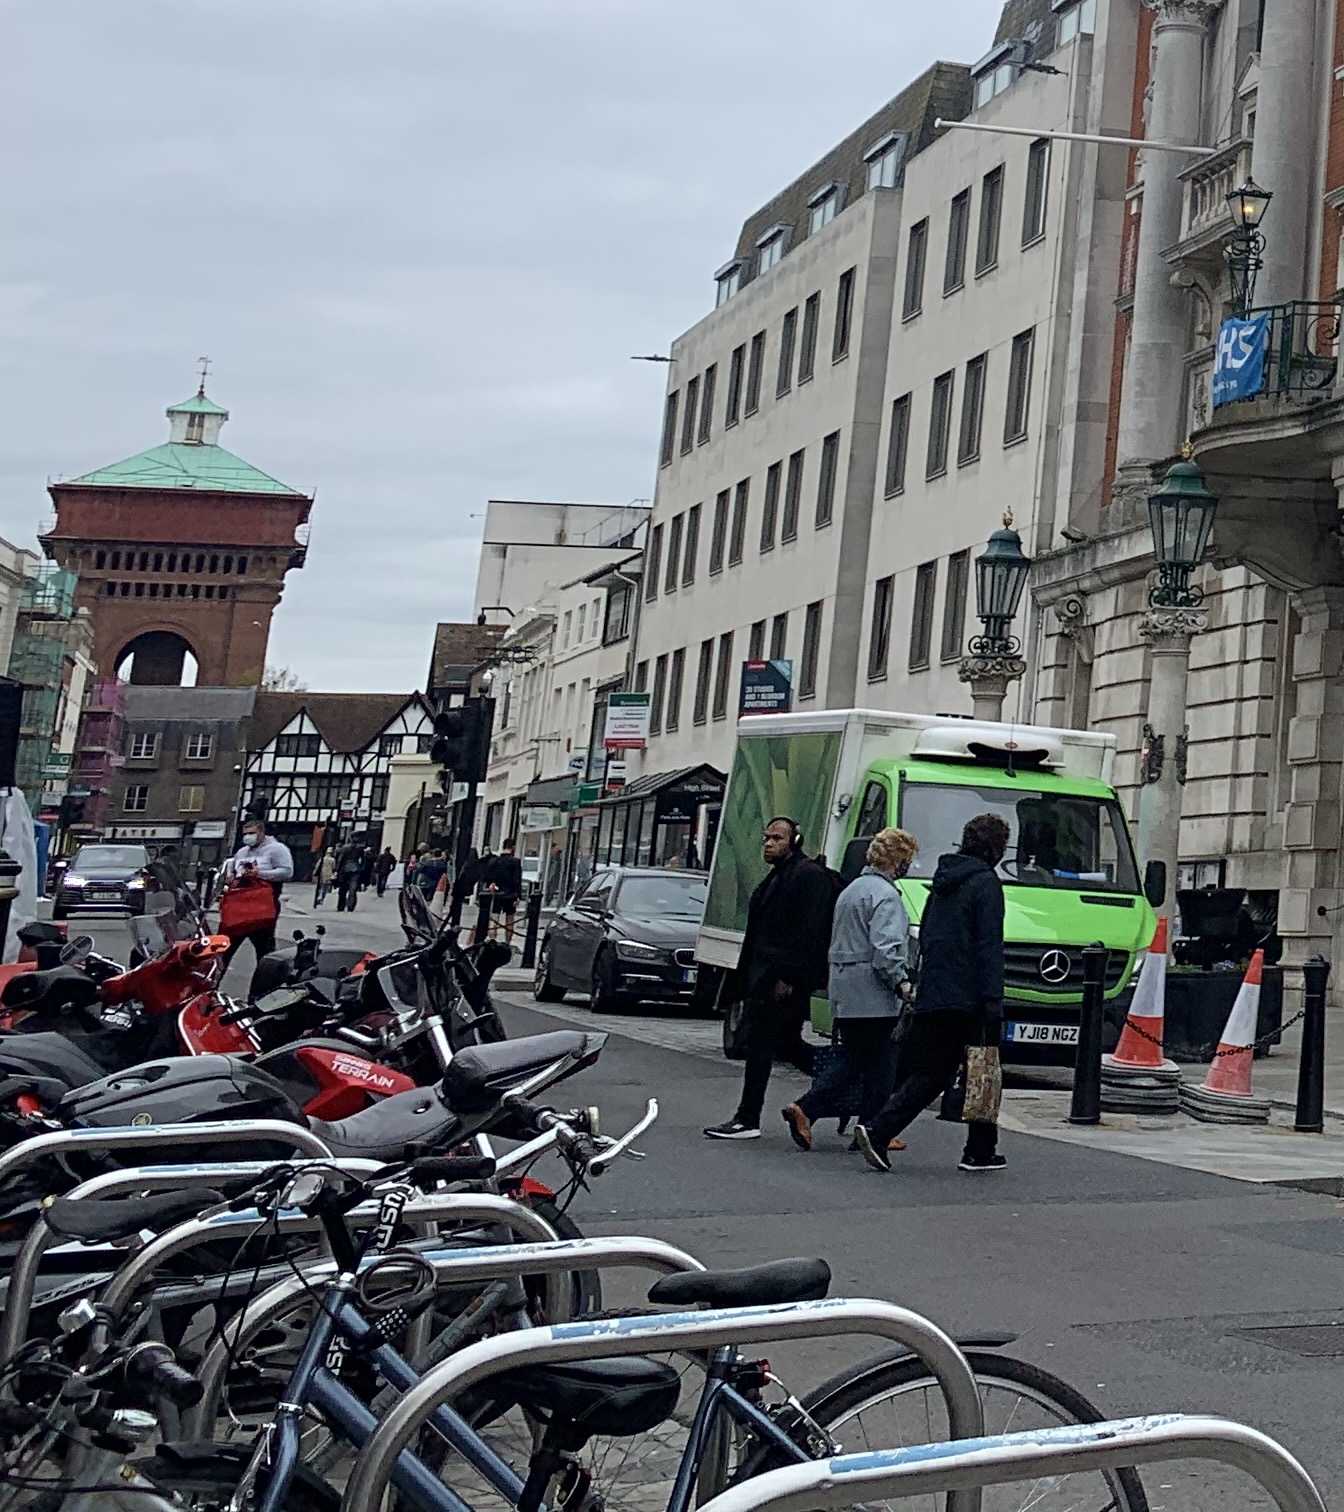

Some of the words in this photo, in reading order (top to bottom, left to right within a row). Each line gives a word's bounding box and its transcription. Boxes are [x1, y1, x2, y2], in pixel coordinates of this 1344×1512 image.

[1020, 1026, 1049, 1040] YJ18
[1052, 1028, 1078, 1041] NGZ
[332, 1060, 395, 1088] TERRAIN
